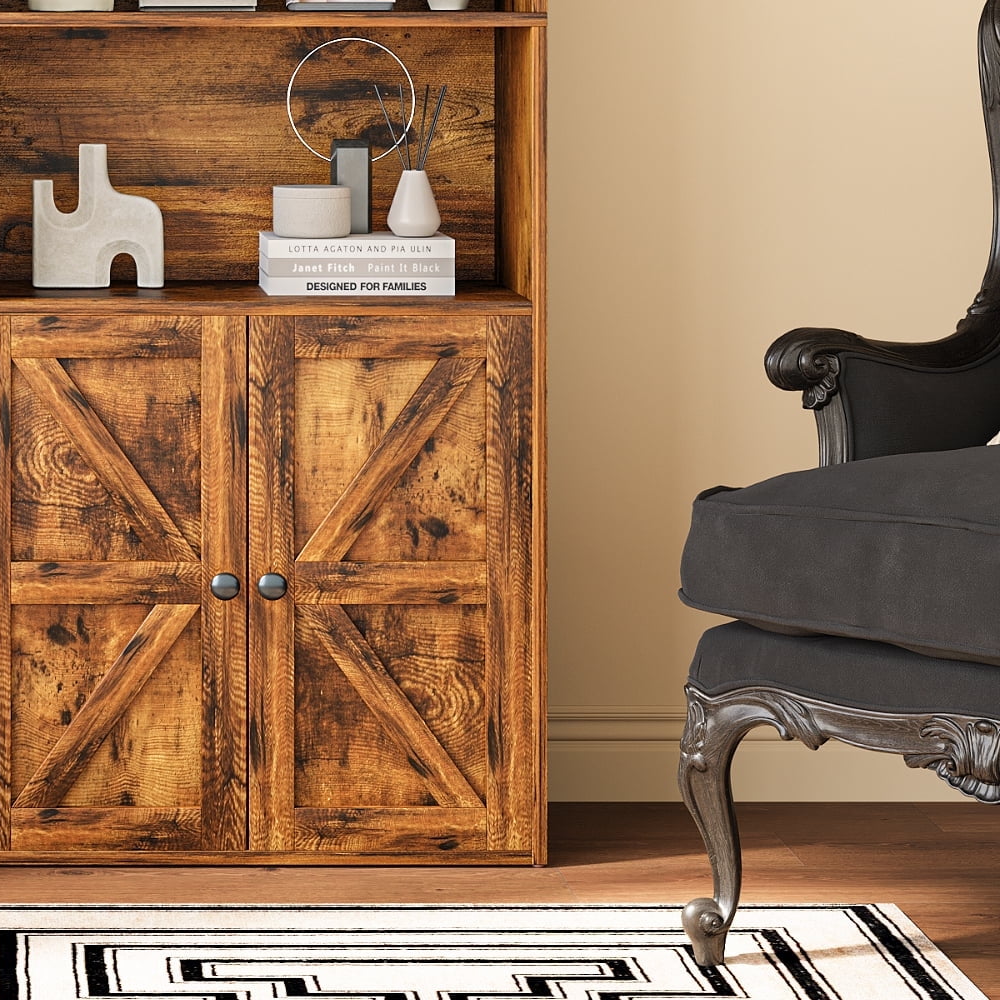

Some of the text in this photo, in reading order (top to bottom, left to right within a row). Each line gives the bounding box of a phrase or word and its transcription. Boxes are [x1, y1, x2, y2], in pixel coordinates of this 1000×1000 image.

[292, 263, 440, 273] Janet Fitch Paint It Black
[306, 282, 427, 291] DESIGNED FOR FAMILIES
